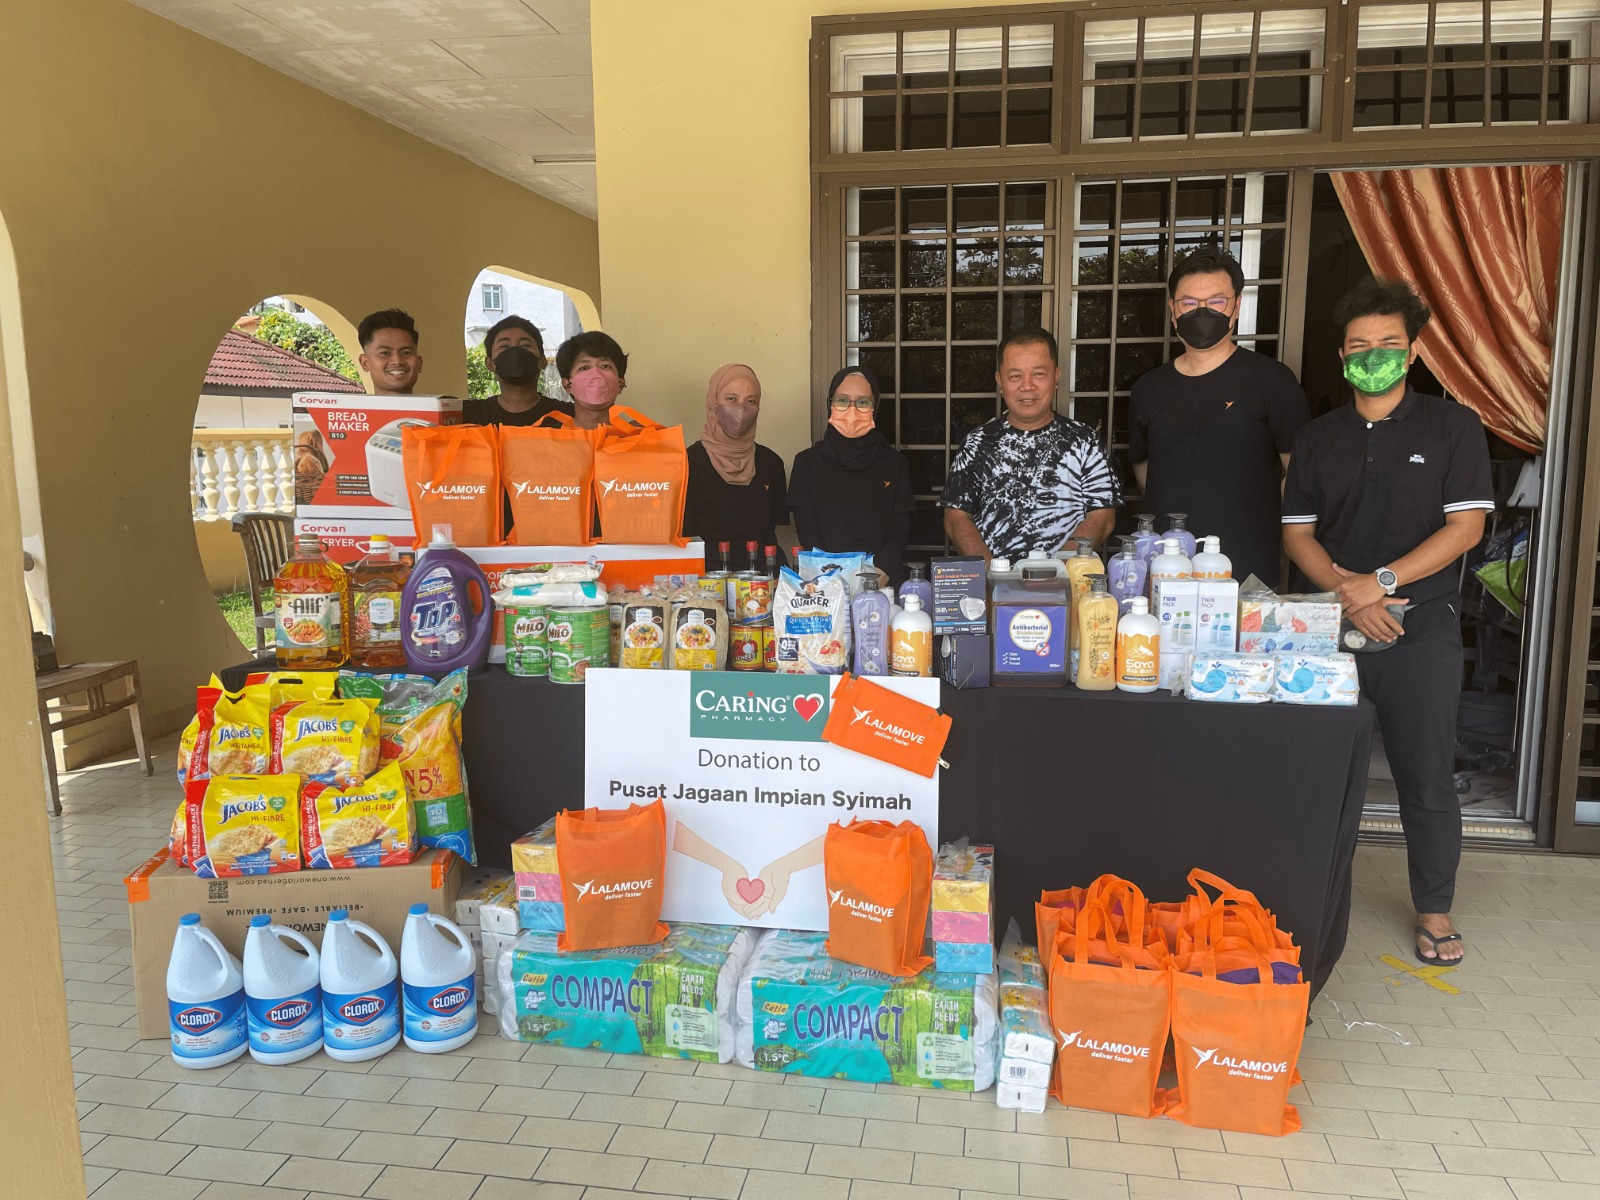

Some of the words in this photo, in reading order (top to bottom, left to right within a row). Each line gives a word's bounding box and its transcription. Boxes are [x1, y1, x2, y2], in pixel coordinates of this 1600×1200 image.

[328, 412, 366, 421] BREAD
[328, 423, 369, 431] MAKER
[431, 484, 486, 494] LALAMOVE
[527, 485, 581, 495] LALAMOVE
[615, 482, 670, 492] LALAMOVE
[288, 598, 324, 614] Alif
[790, 596, 829, 608] QUAKER
[516, 622, 544, 633] MILO
[1126, 658, 1154, 668] Soya
[700, 714, 787, 723] PHARMACY
[217, 725, 251, 744] JACOB'S
[294, 718, 338, 741] JACOB'S
[863, 716, 926, 745] LALAMOVE
[874, 730, 892, 741] deliver
[890, 735, 910, 747] faster
[698, 748, 793, 771] Donation
[799, 753, 821, 772] to
[609, 781, 668, 799] Pusat
[673, 784, 749, 805] Jagaan
[754, 786, 825, 807] Impian
[832, 789, 912, 810] Syimah
[218, 794, 266, 824] JACOB'S
[362, 804, 396, 812] HI-FIBRE
[306, 814, 314, 847] ON-THE-GO
[236, 876, 351, 885] www.oneworldberhad.com
[590, 878, 653, 895] LALAMOVE
[226, 908, 273, 916] PREMIUM
[840, 897, 895, 918] LALAMOVE
[850, 910, 867, 920] deliver
[866, 914, 882, 923] faster
[681, 972, 704, 986] EARTH
[551, 974, 653, 1016] COMPACT
[681, 983, 704, 996] NEEDS
[433, 991, 466, 1008] CLOROX
[681, 994, 691, 1004] US
[934, 998, 960, 1013] EARTH
[271, 1003, 307, 1021] CLOROX
[344, 1001, 379, 1017] CLOROX
[180, 1012, 216, 1026] CLOROX
[934, 1011, 960, 1022] NEEDS
[526, 1022, 551, 1032] 1.5°C
[793, 1003, 904, 1044] COMPACT
[934, 1021, 944, 1033] US
[1076, 1038, 1150, 1058] LALAMOVE
[763, 1052, 790, 1065] 1.5°C
[1091, 1051, 1113, 1060] deliver
[1114, 1055, 1134, 1064] faster
[1213, 1054, 1288, 1073] LALAMOVE
[1228, 1069, 1252, 1078] deliver
[1253, 1072, 1274, 1081] faster
